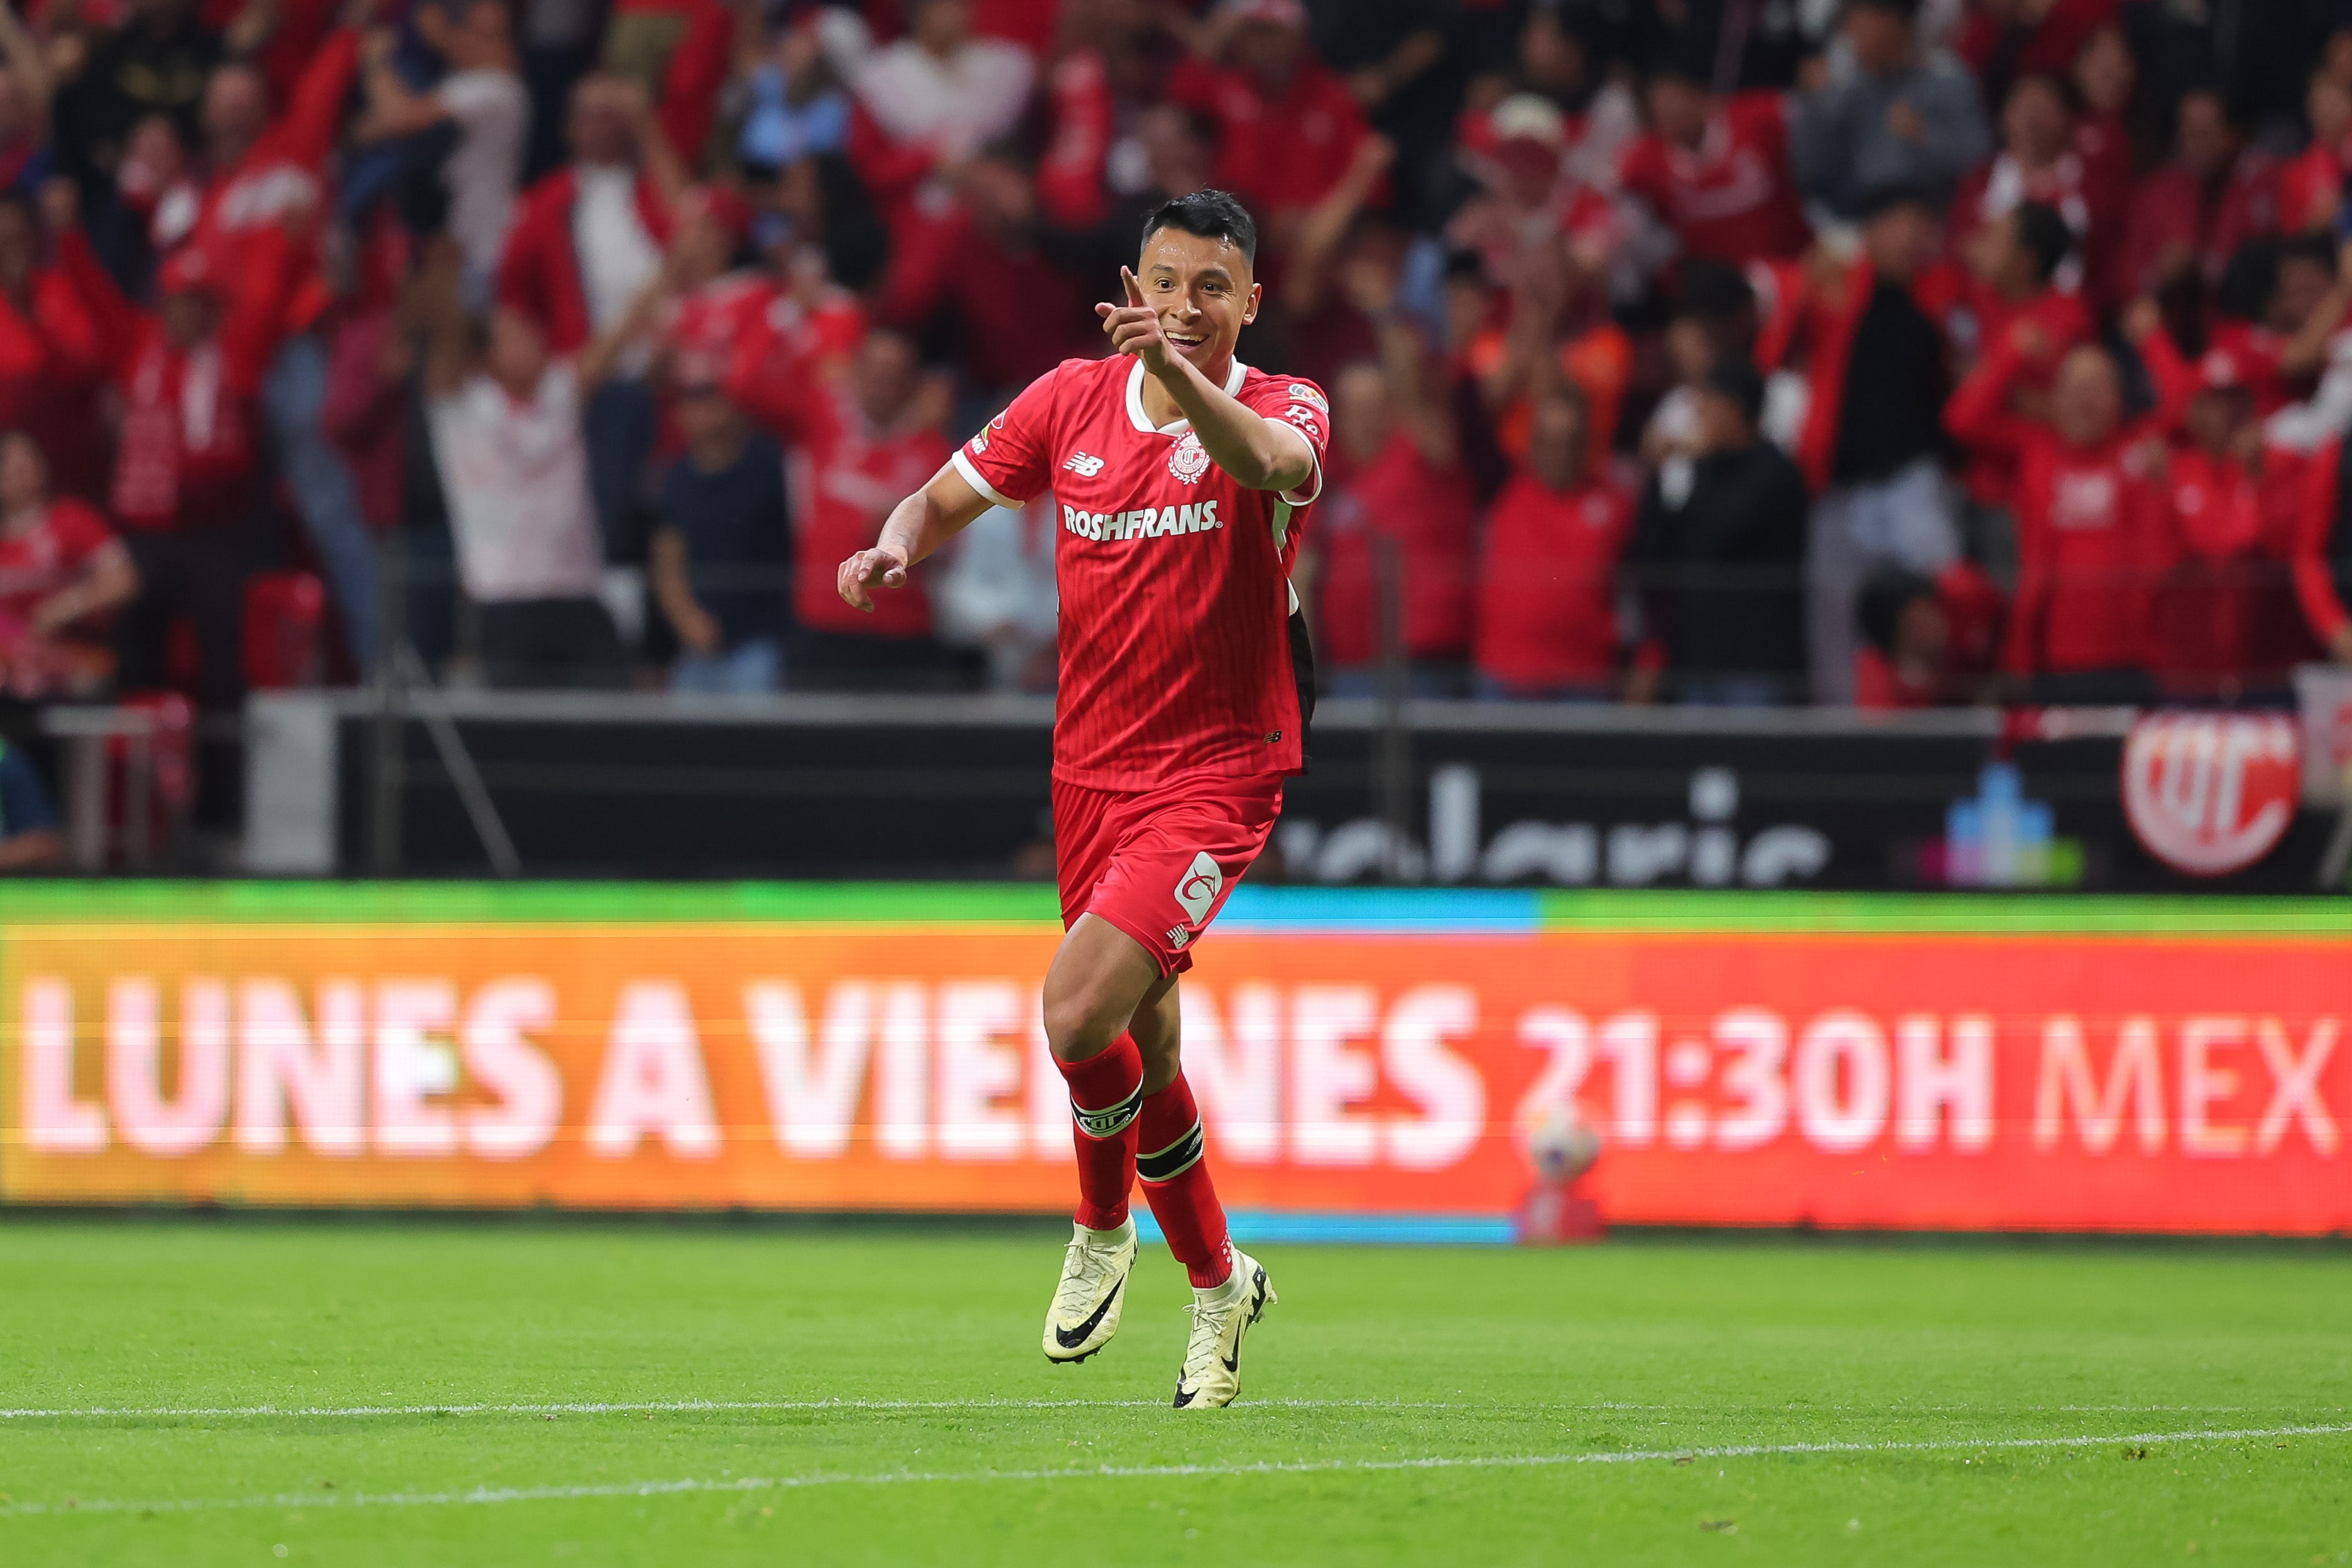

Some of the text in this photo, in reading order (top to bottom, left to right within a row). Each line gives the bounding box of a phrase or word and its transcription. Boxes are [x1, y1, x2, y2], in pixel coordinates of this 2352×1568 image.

[1063, 500, 1217, 542] ROSHFRANS
[23, 974, 2341, 1170] LUNES A VIENES 21:30H MEX
